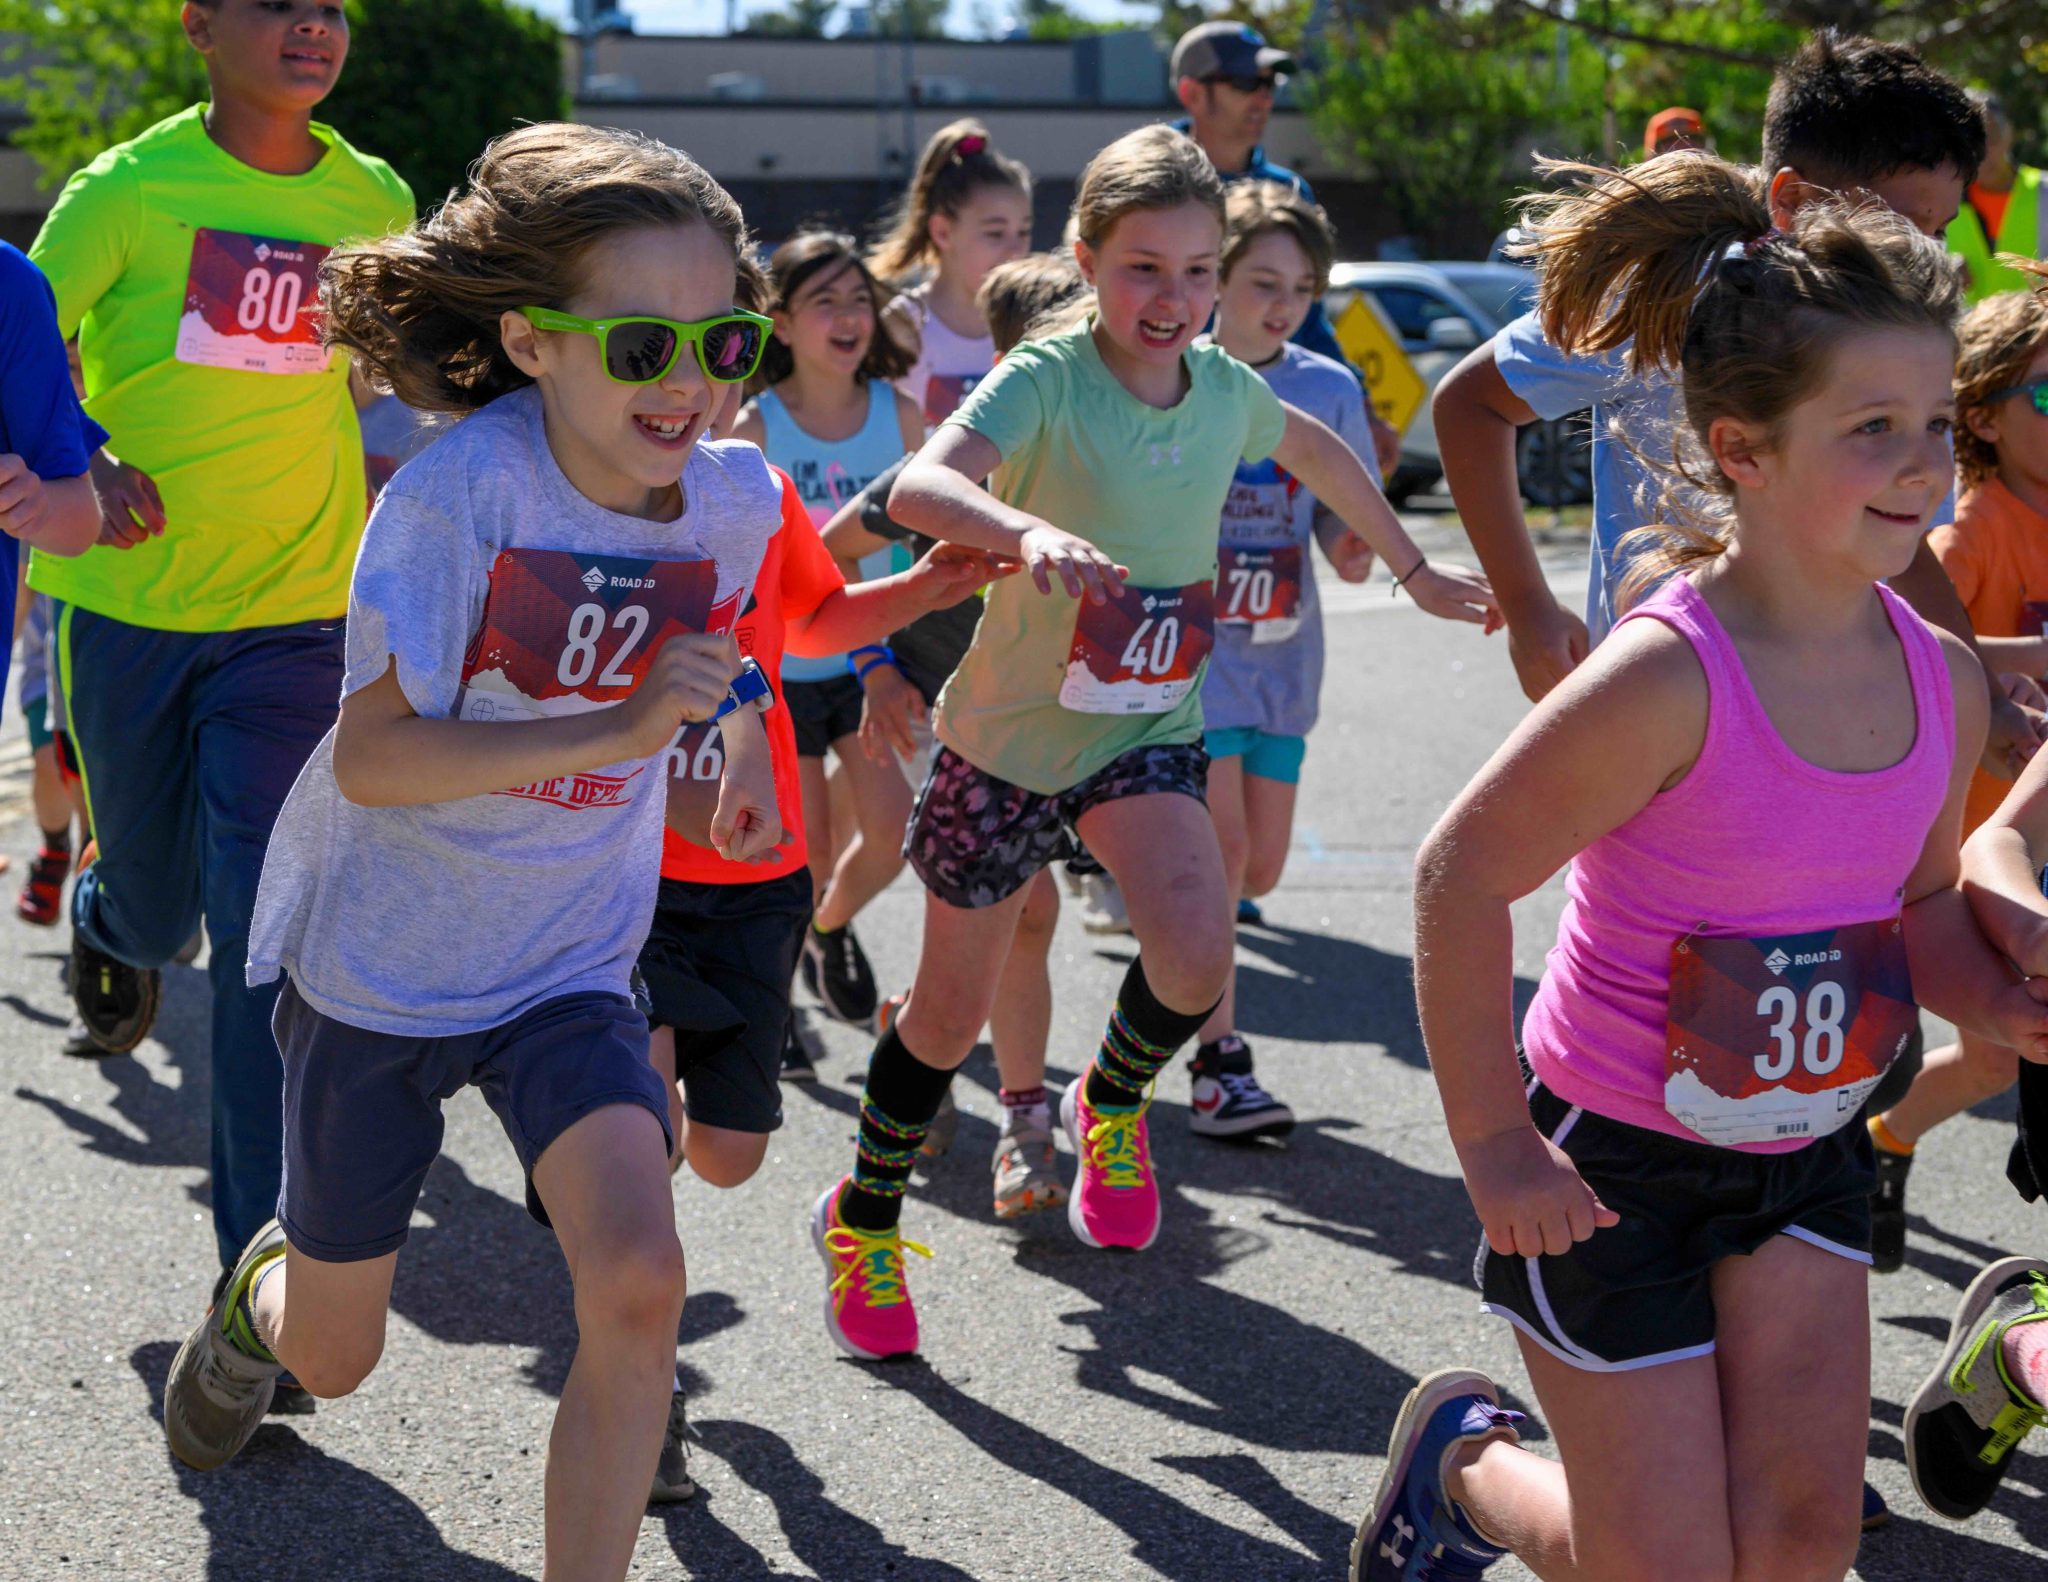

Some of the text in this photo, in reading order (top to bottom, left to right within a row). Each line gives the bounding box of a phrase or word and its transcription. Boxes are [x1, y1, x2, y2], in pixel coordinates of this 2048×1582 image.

[237, 267, 302, 334] 80
[610, 576, 642, 588] ROAD
[1227, 569, 1274, 615] 70
[556, 602, 650, 687] 82
[1120, 616, 1179, 675] 40
[666, 726, 723, 780] 66
[1795, 951, 1827, 966] ROAD
[1754, 980, 1846, 1080] 38
